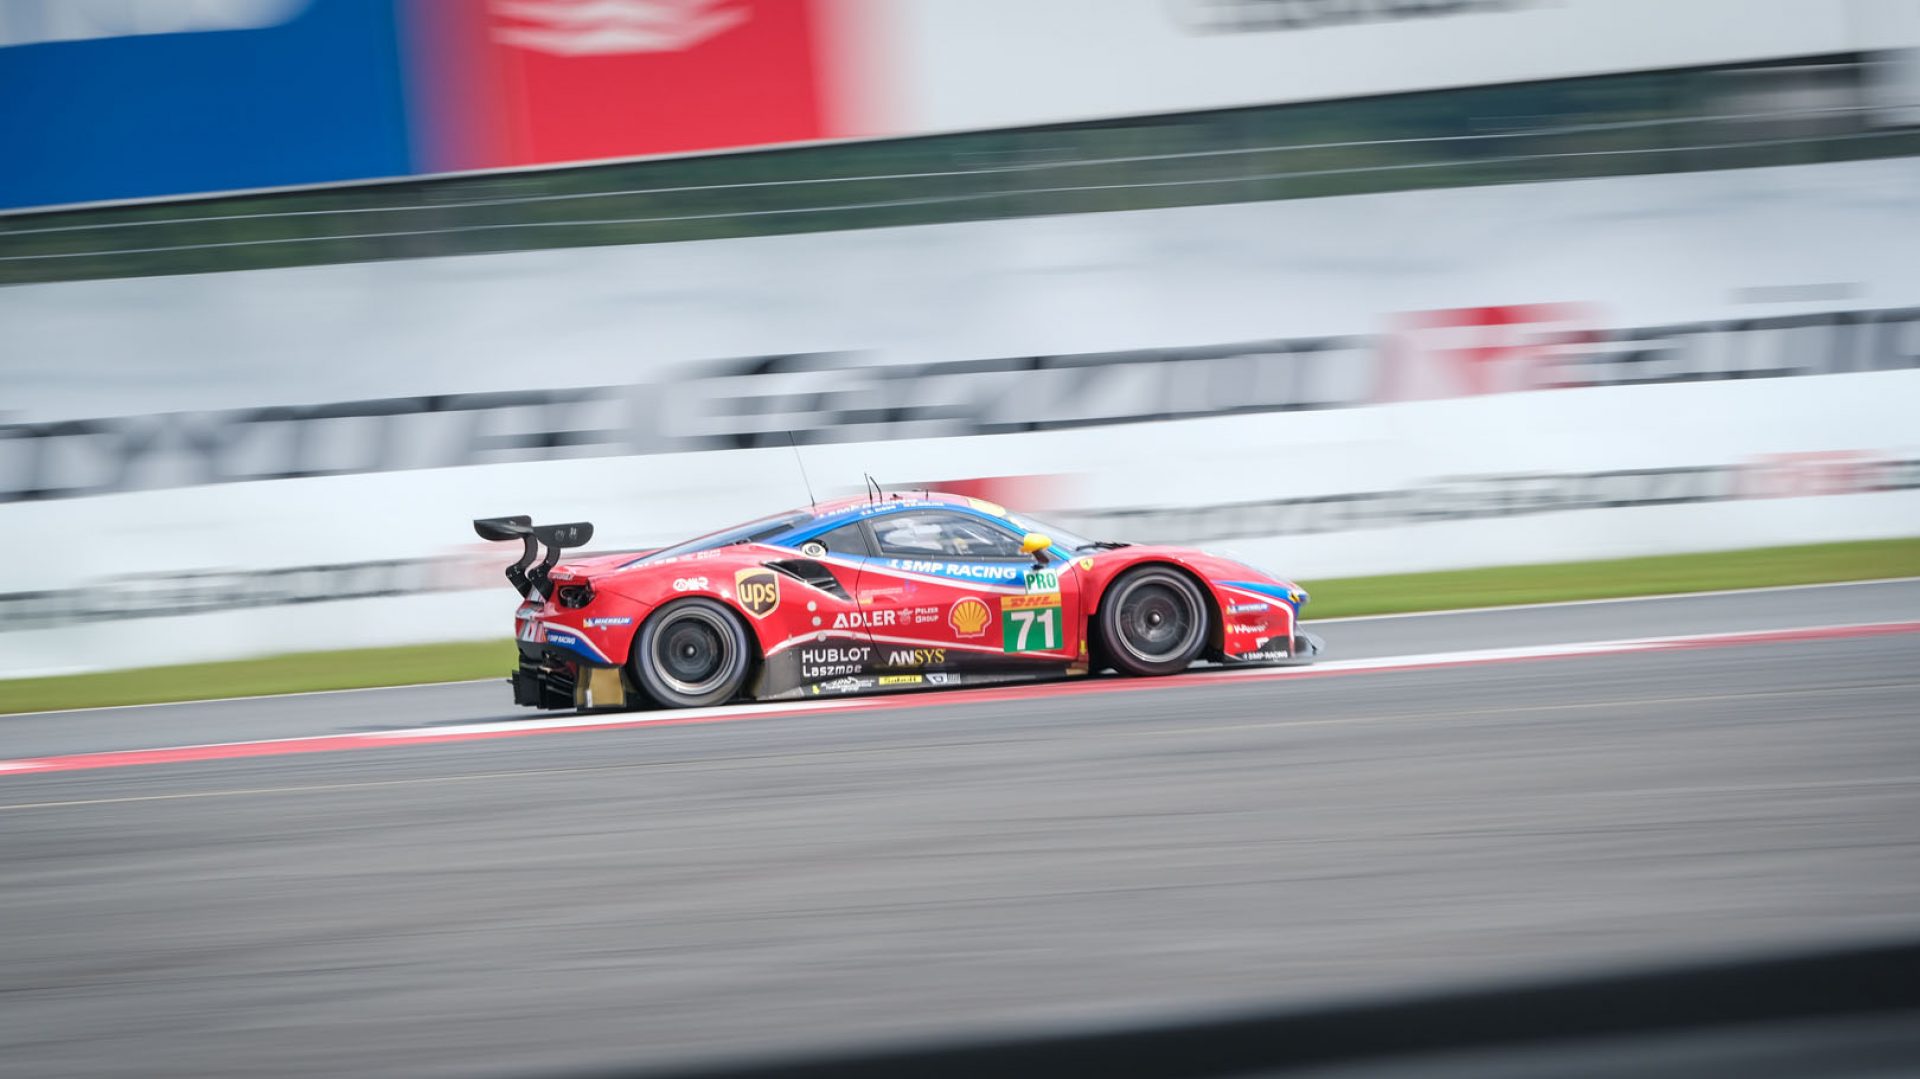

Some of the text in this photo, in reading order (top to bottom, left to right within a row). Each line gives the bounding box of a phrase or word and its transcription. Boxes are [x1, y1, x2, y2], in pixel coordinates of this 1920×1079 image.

[902, 560, 1017, 579] SMP RACING
[1026, 573, 1057, 590] PRO
[740, 583, 776, 610] ups
[1010, 596, 1053, 608] DHL
[832, 610, 896, 629] ADLER
[1011, 609, 1055, 651] 71
[802, 647, 871, 663] HUBLOT
[888, 648, 946, 666] ANSYS
